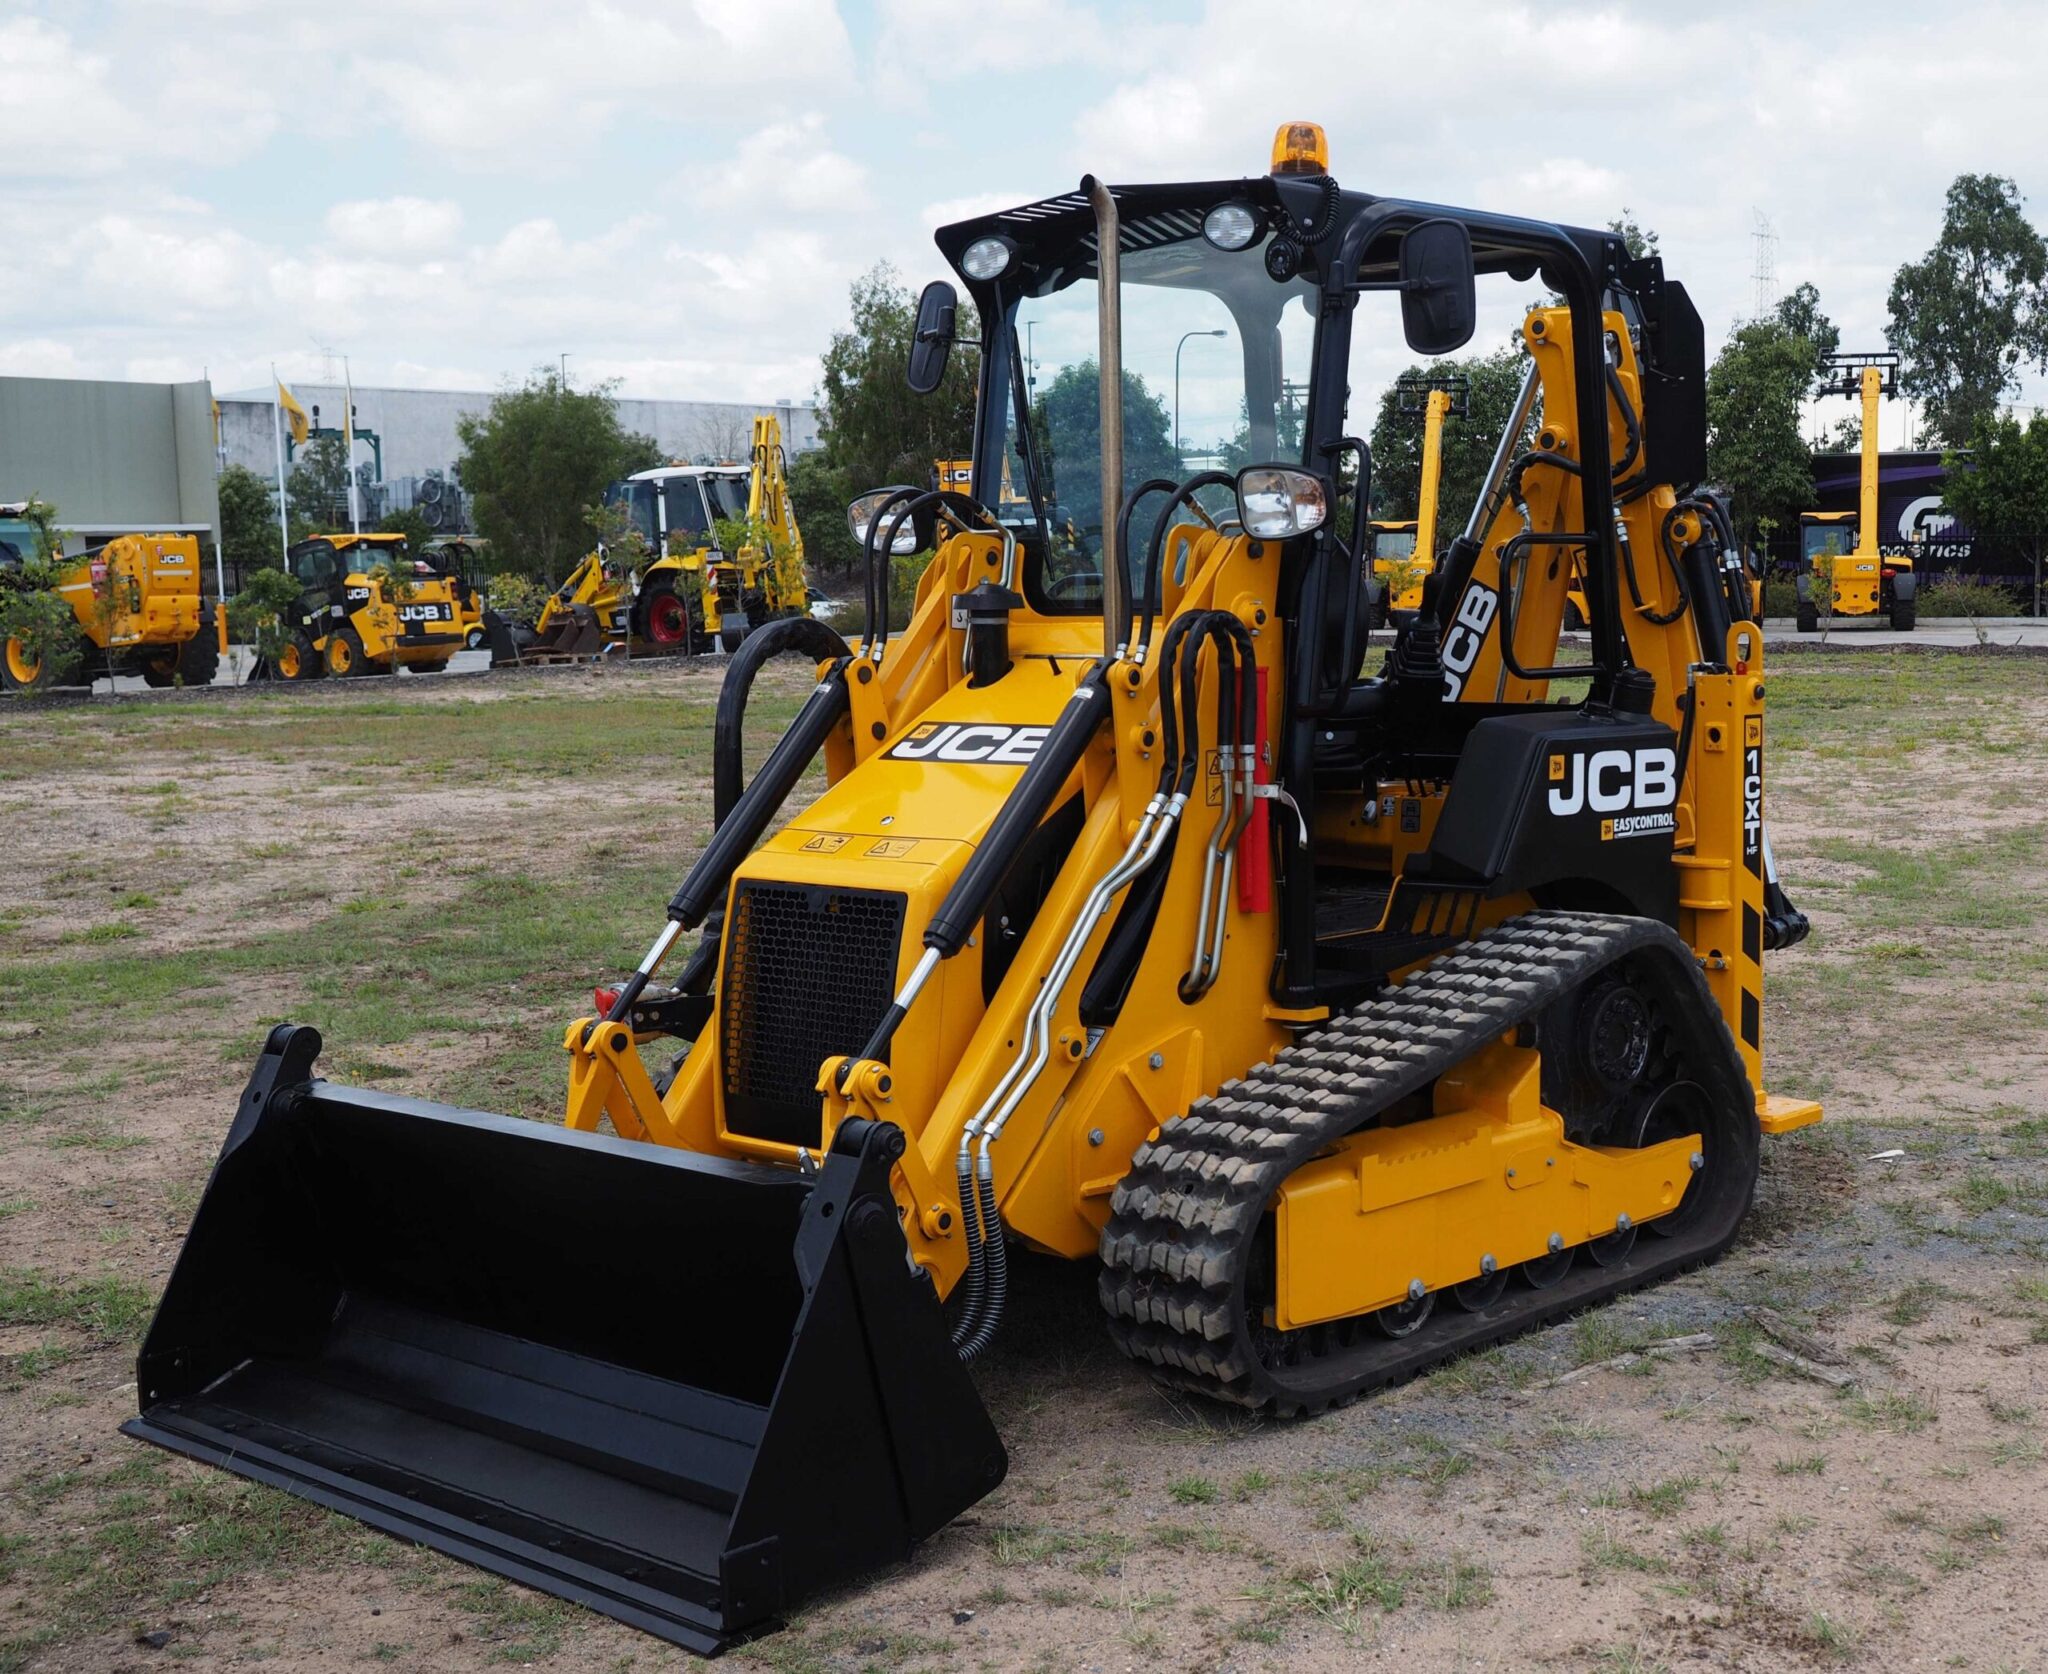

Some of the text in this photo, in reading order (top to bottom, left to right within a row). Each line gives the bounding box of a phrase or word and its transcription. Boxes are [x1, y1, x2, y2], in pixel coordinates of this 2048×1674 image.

[160, 555, 184, 564] JCB
[347, 587, 370, 600] JCB
[400, 606, 439, 621] JCB
[1441, 584, 1498, 703] JCB
[1548, 747, 1677, 817] JCB
[1744, 749, 1761, 845] 1CXT
[1746, 845, 1758, 856] HF
